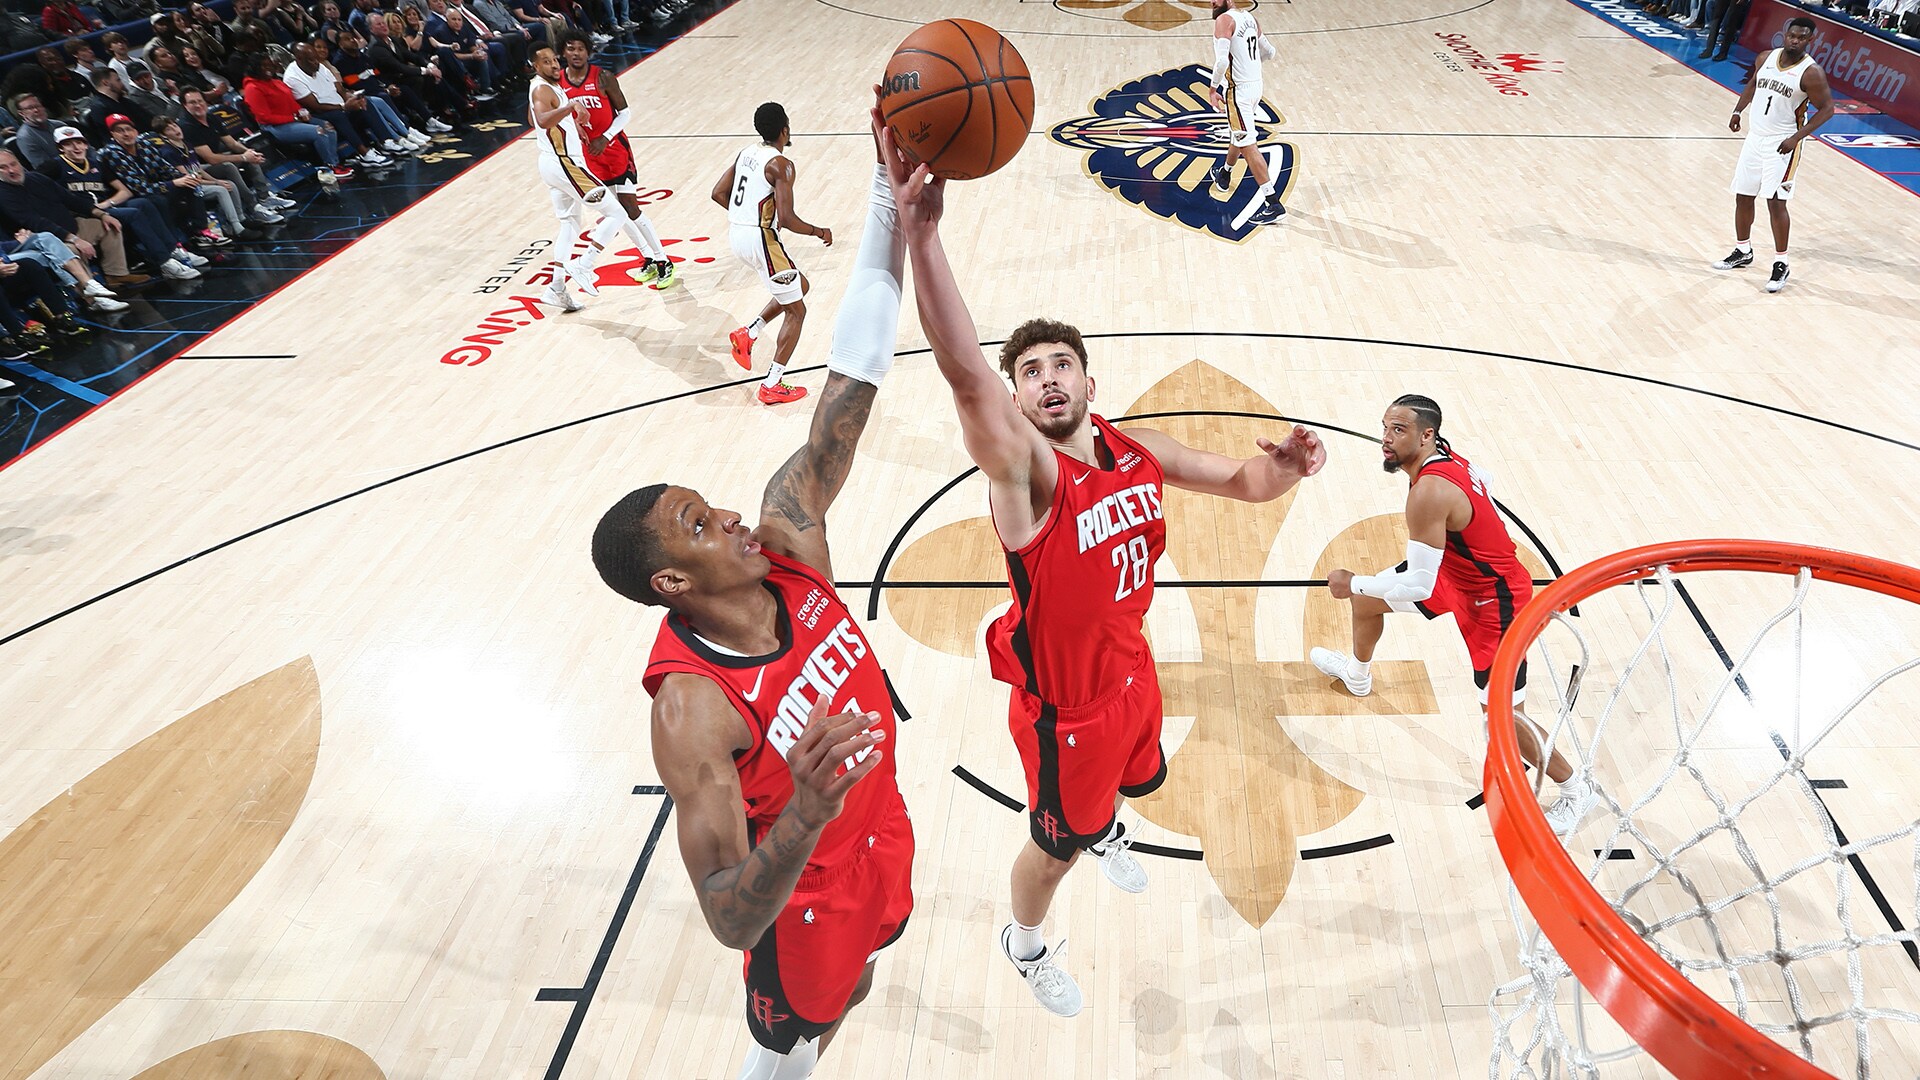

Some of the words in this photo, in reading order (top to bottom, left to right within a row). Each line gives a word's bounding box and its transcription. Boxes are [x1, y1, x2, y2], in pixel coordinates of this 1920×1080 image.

[1246, 36, 1257, 61] 17
[1764, 95, 1773, 115] 1
[1768, 79, 1794, 99] ORLEANS
[734, 175, 748, 207] 5
[472, 239, 553, 295] CENTER
[1119, 456, 1142, 473] arma
[1076, 482, 1163, 555] ROCKETS
[1111, 534, 1149, 603] 28
[796, 587, 822, 622] credit
[803, 597, 830, 631] karma
